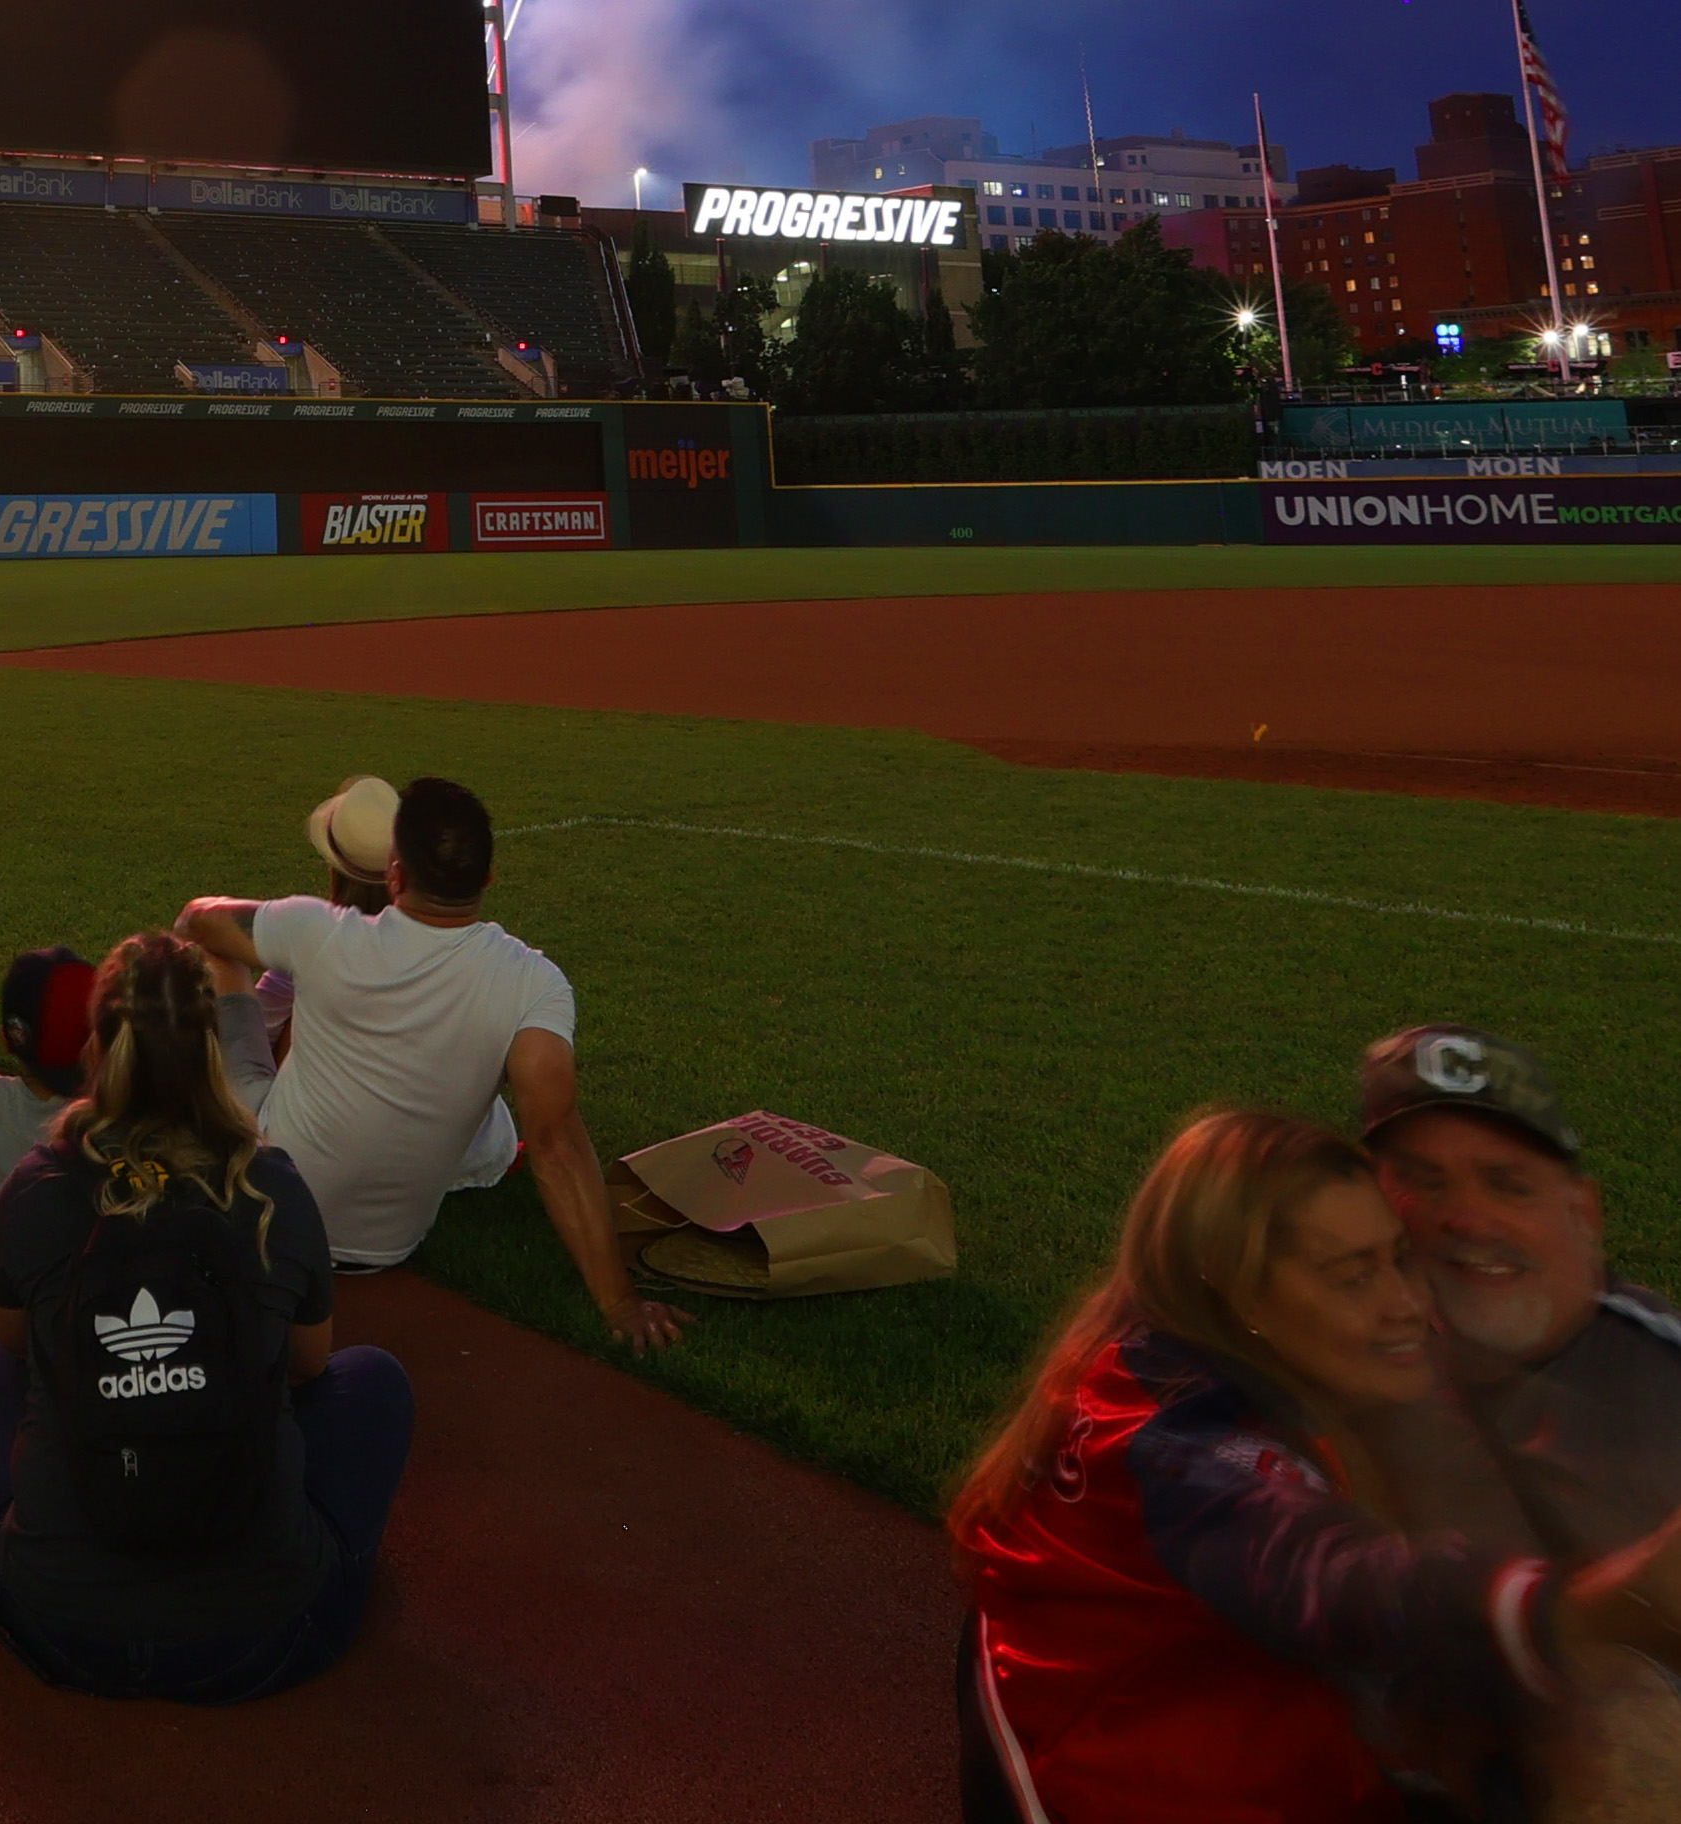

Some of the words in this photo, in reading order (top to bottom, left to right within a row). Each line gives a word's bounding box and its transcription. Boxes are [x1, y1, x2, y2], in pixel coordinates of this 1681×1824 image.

[191, 180, 302, 209] DollarBank
[329, 187, 436, 215] DollarBank
[693, 188, 962, 244] PROGRESSIVE
[26, 401, 94, 414] PROGRESSIVE
[118, 402, 185, 415] PROGRESSIVE
[208, 403, 272, 416] PROGRESSIVE
[293, 405, 355, 417] PROGRESSIVE
[376, 406, 437, 418] PROGRESSIVE
[457, 407, 516, 418] PROGRESSIVE
[535, 407, 591, 418] PROGRESSIVE
[1363, 418, 1478, 440] MEDICAL
[1488, 415, 1597, 436] MUTUAL
[629, 439, 730, 488] meijer
[1260, 461, 1347, 479] MOEN
[1467, 457, 1562, 477] MOEN
[323, 504, 426, 544] BLASTER
[484, 512, 596, 531] CRAFTSMAN
[949, 527, 973, 539] 400
[98, 1363, 206, 1399] adidas
